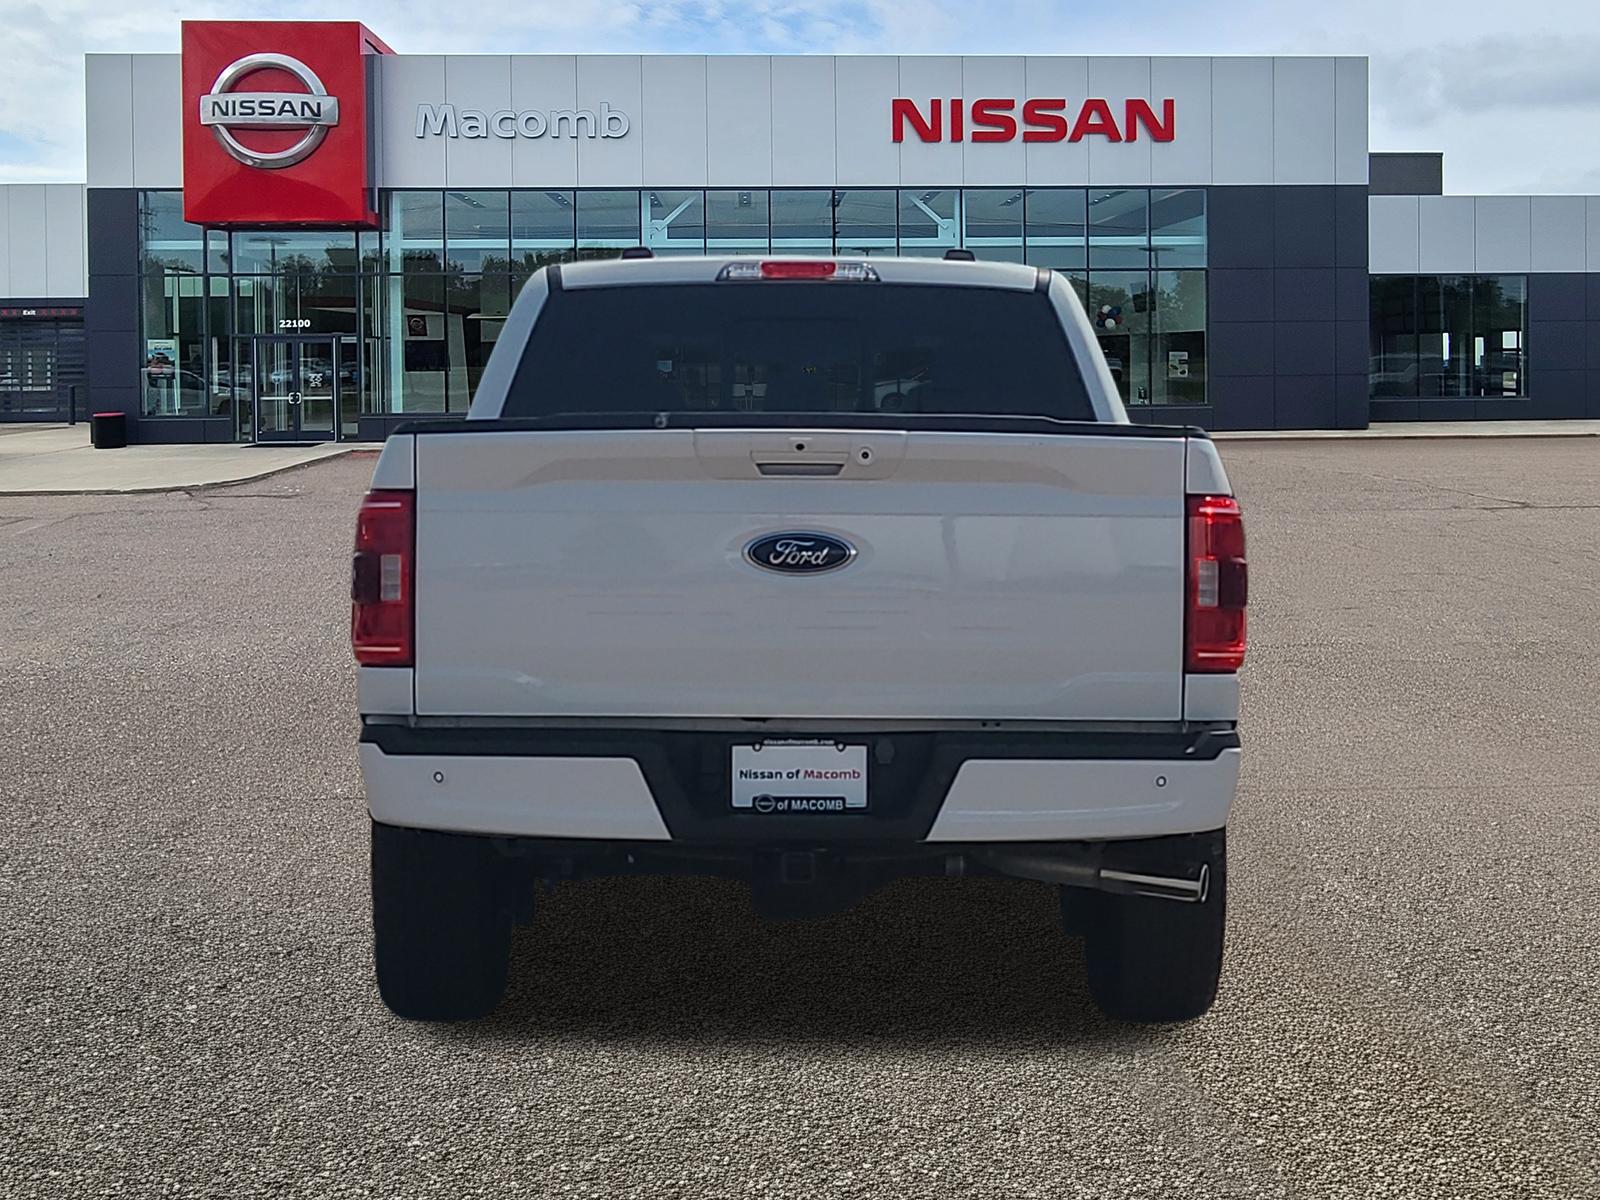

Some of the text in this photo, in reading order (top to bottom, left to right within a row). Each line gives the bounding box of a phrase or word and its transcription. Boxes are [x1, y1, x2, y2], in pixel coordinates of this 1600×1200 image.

[211, 100, 322, 117] NISSAN
[415, 102, 630, 139] Macomb
[892, 98, 1175, 143] NISSAN
[279, 319, 311, 328] 22100
[769, 539, 830, 565] Ford
[739, 769, 861, 780] Nissan of Macomb
[777, 799, 789, 811] of
[791, 799, 844, 811] MACOMB
